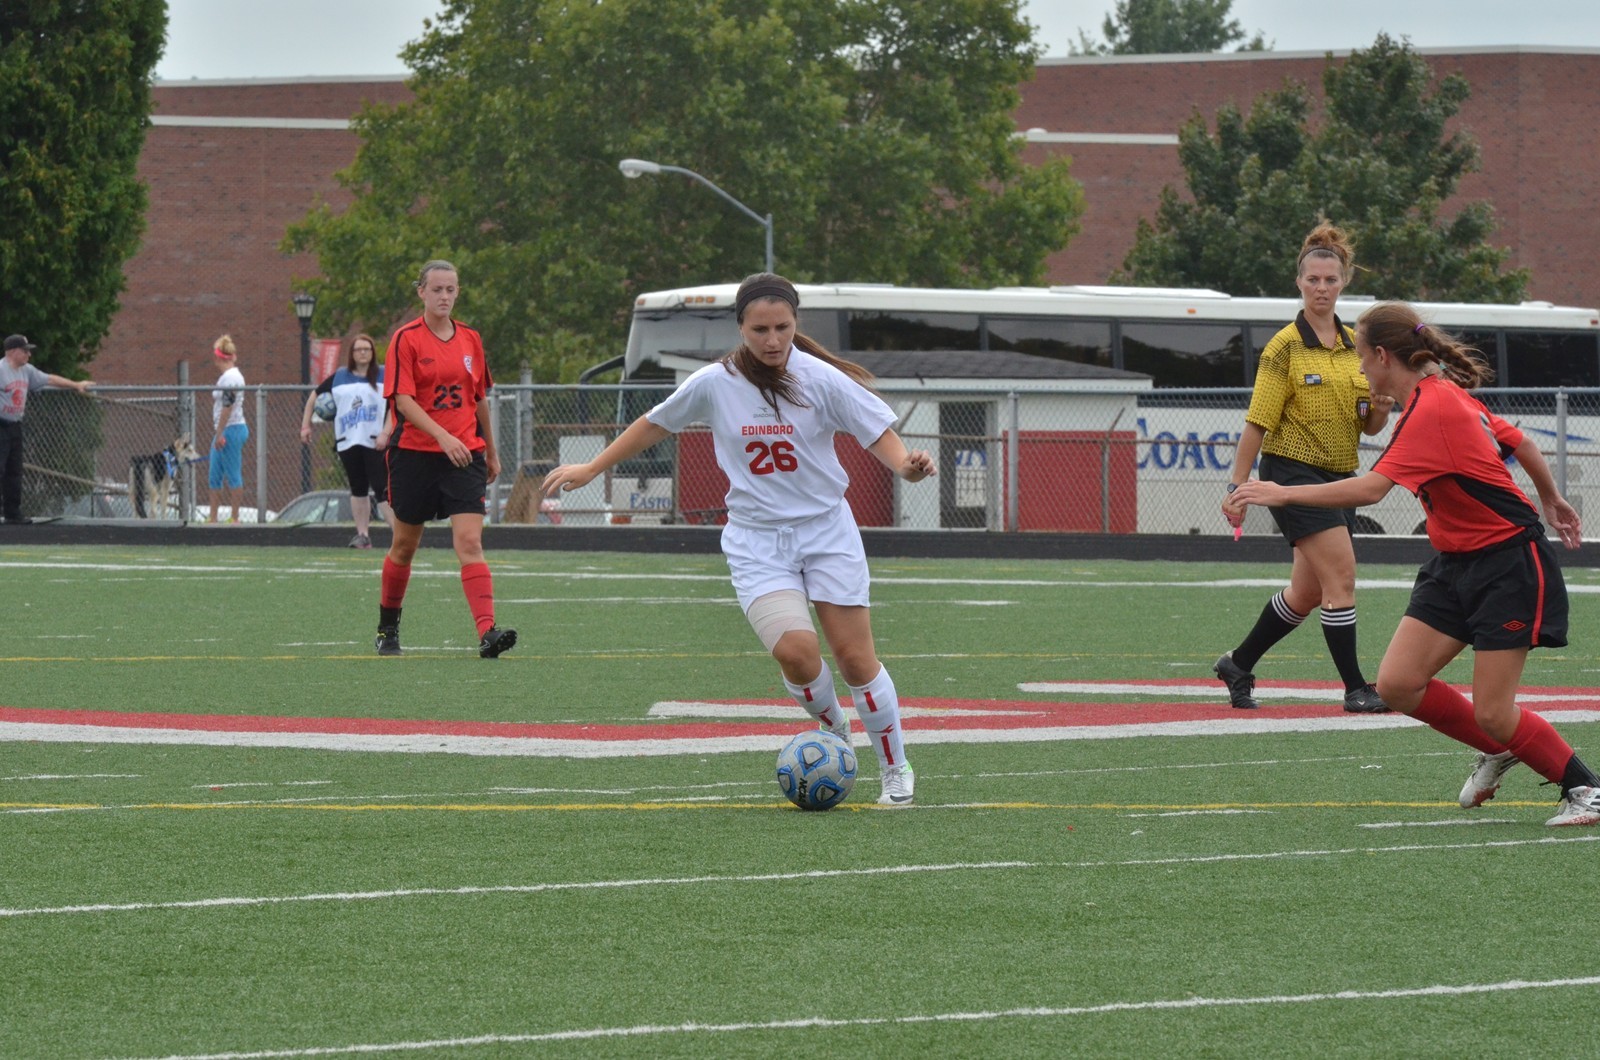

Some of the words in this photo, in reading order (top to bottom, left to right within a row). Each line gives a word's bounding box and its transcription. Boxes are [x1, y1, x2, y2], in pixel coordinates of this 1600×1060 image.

[433, 384, 463, 409] 25
[741, 425, 794, 436] EDINBORO
[1137, 418, 1258, 469] OAC
[745, 440, 798, 475] 26
